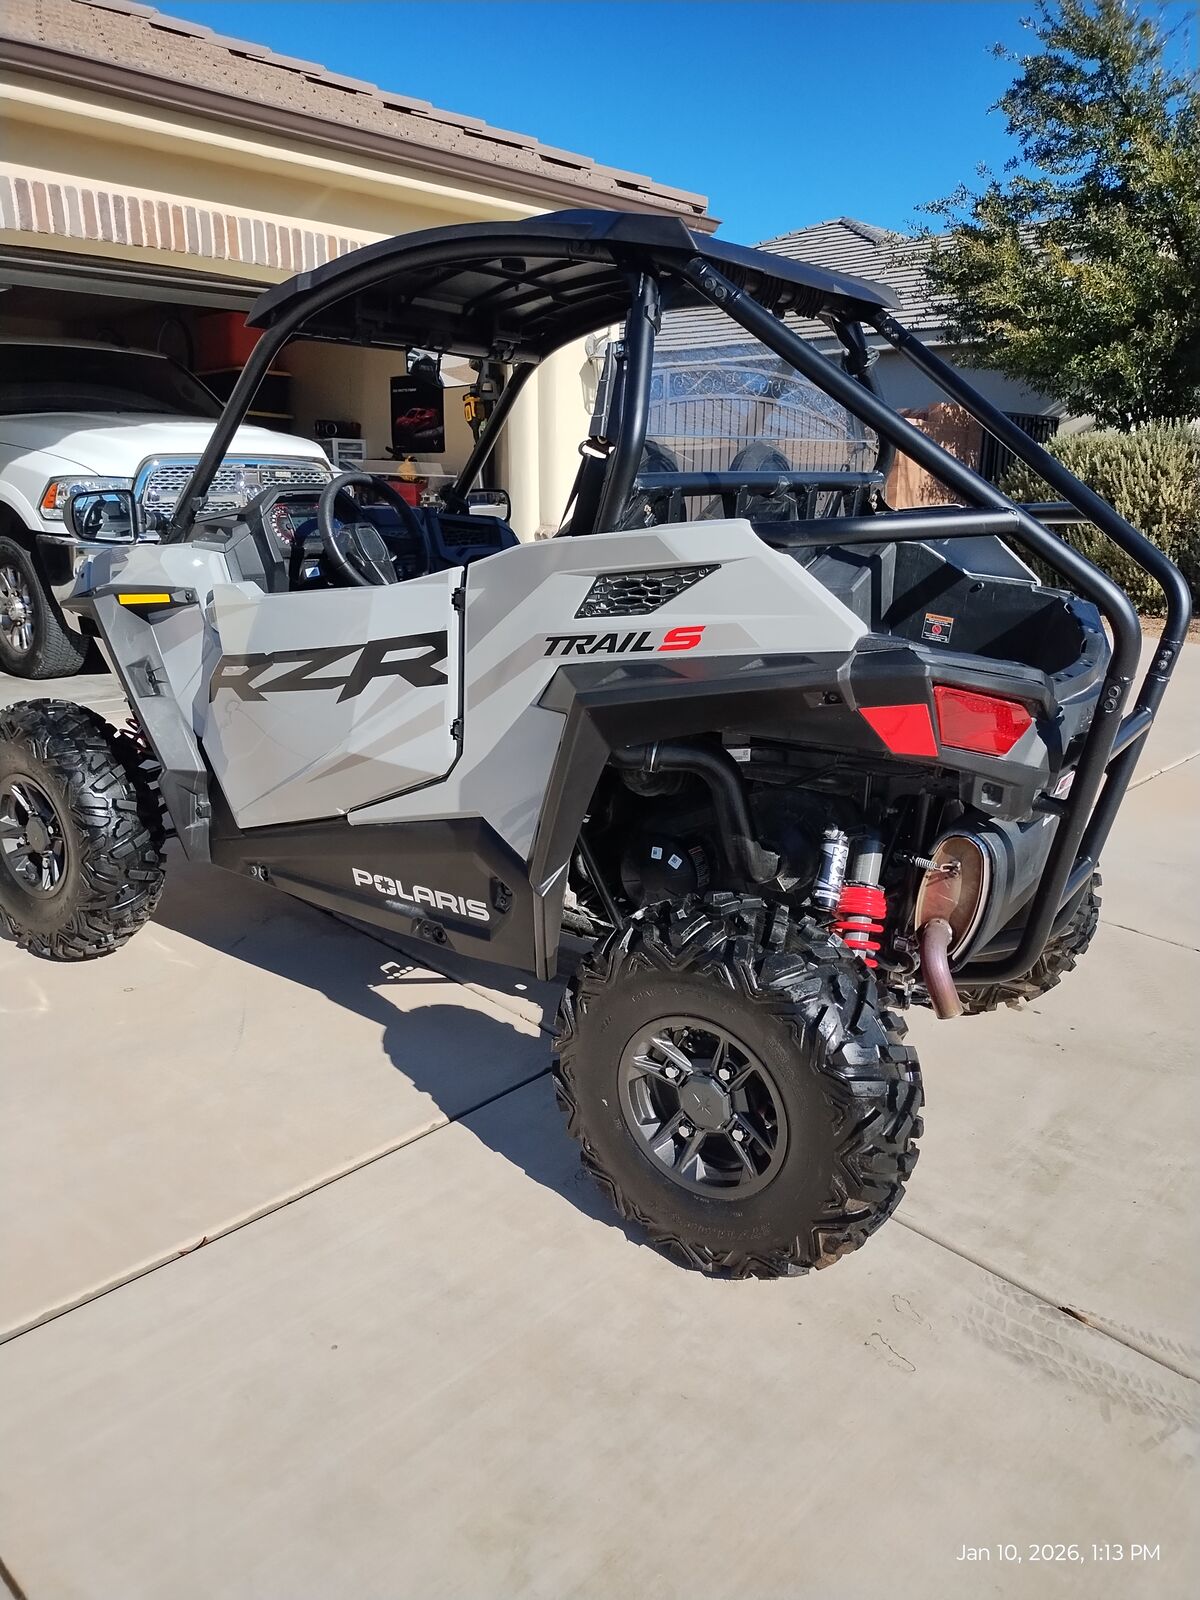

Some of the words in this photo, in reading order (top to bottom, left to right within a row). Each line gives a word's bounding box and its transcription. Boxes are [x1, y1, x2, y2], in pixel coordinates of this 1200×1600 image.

[208, 629, 449, 704] RZR
[543, 631, 655, 657] TRAIL
[656, 625, 706, 652] S
[351, 867, 491, 922] POLARIS
